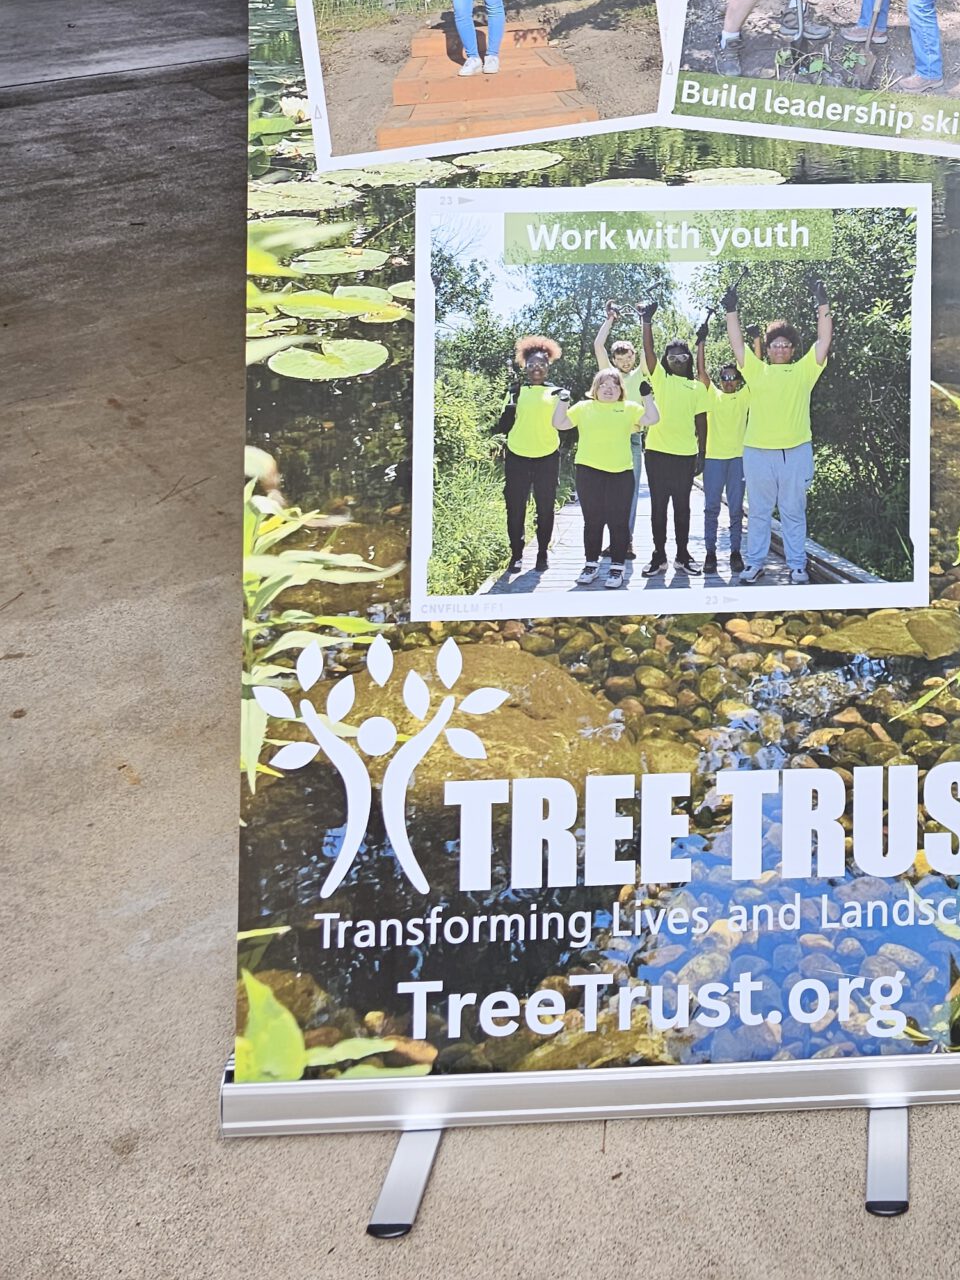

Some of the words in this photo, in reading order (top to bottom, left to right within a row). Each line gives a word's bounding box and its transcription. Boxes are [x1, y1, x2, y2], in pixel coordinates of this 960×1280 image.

[681, 79, 756, 112] Build
[764, 88, 913, 132] leadership
[527, 222, 617, 251] Work
[626, 222, 700, 250] with
[707, 219, 811, 257] youth
[444, 772, 692, 892] TREE
[315, 904, 593, 949] Transforming
[612, 897, 708, 936] Lives
[728, 893, 800, 932] and
[398, 968, 907, 1040] TreeTrust.org
